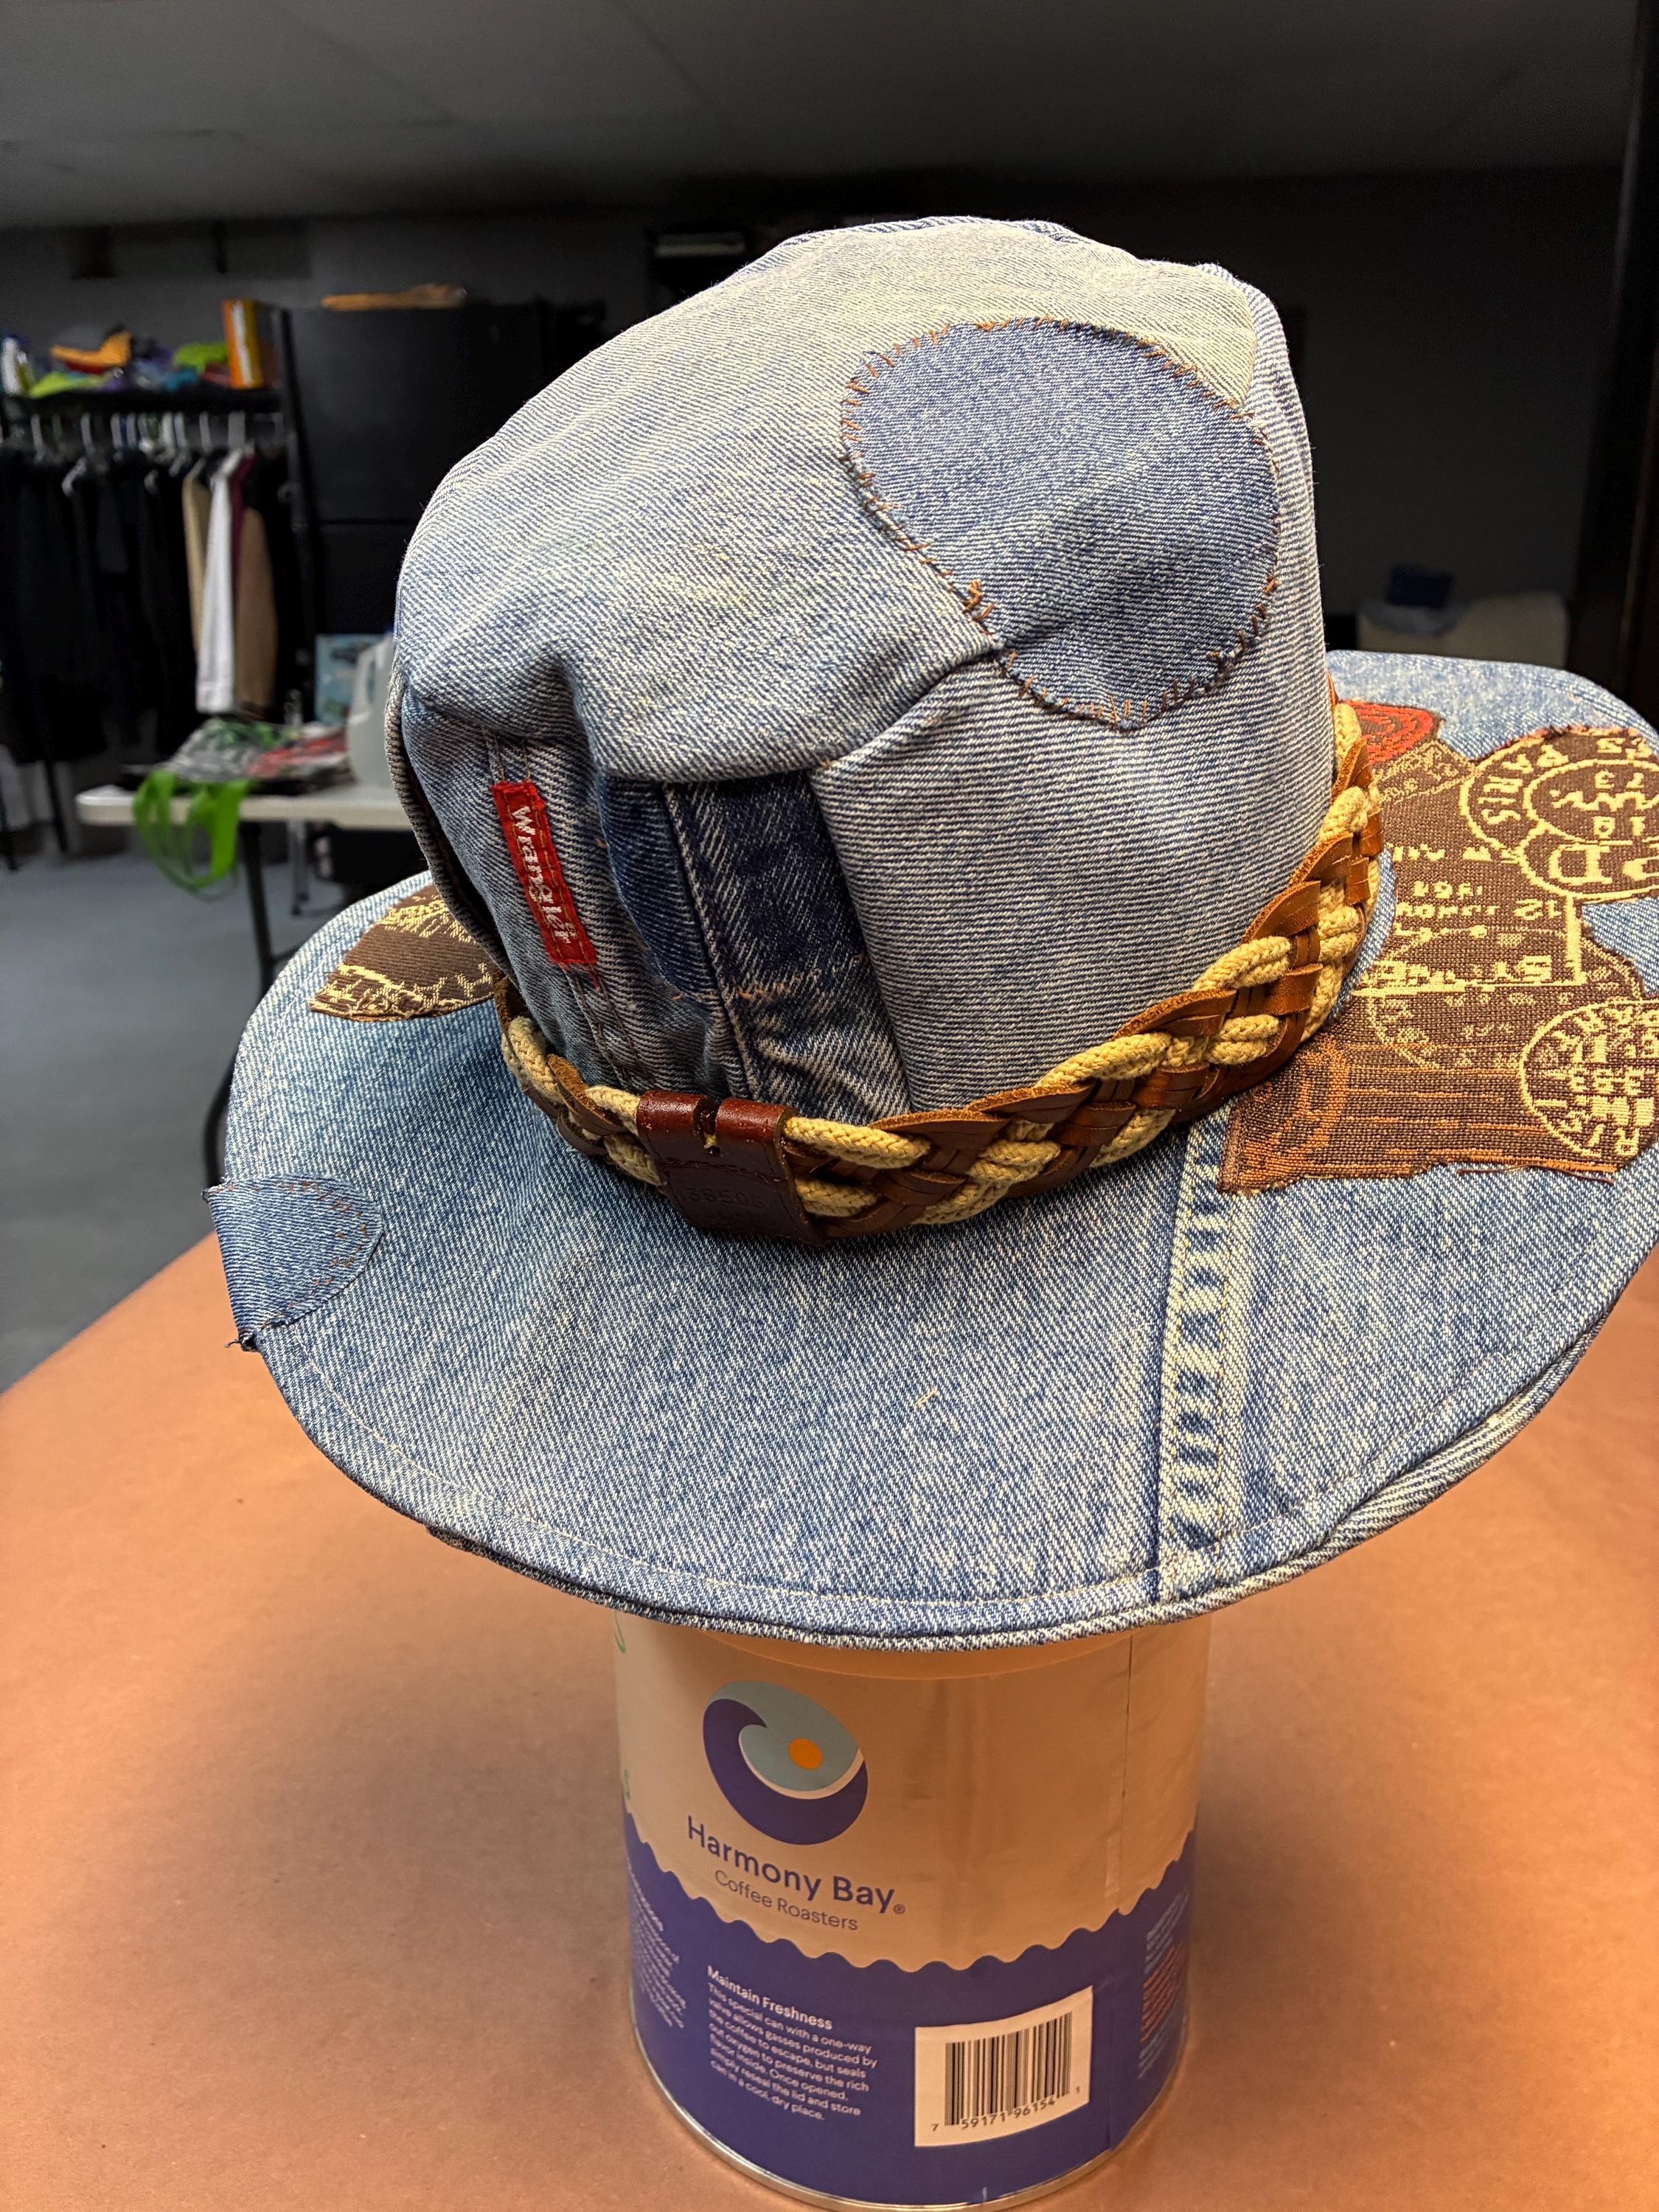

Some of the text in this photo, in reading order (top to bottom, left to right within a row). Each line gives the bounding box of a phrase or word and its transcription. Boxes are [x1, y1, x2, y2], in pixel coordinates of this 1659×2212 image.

[511, 805, 577, 945] Wrangler
[687, 1815, 821, 1901] Harmony
[714, 1869, 859, 1931] Coffee Roasters
[707, 1964, 833, 2031] Maintain Freshness
[764, 2017, 784, 2031] can
[785, 2025, 810, 2039] with
[812, 2034, 819, 2042] a
[820, 2037, 872, 2055] one-way
[765, 2031, 801, 2050] gasses
[802, 2045, 860, 2065] produced
[861, 2056, 878, 2069] by
[757, 2039, 770, 2050] to
[814, 2058, 835, 2073] but
[836, 2066, 866, 2079] seals
[761, 2053, 773, 2065] to
[774, 2060, 824, 2082] preserve
[824, 2075, 845, 2088] the
[846, 2079, 870, 2093] rich
[769, 2068, 800, 2088] Once
[771, 2096, 790, 2110] dry
[772, 2082, 790, 2097] the
[791, 2090, 806, 2102] lid
[807, 2096, 829, 2110] and
[830, 2102, 861, 2116] store
[932, 2123, 939, 2132] 7
[961, 2112, 1006, 2130] 59171
[1013, 2096, 1056, 2119] 96154
